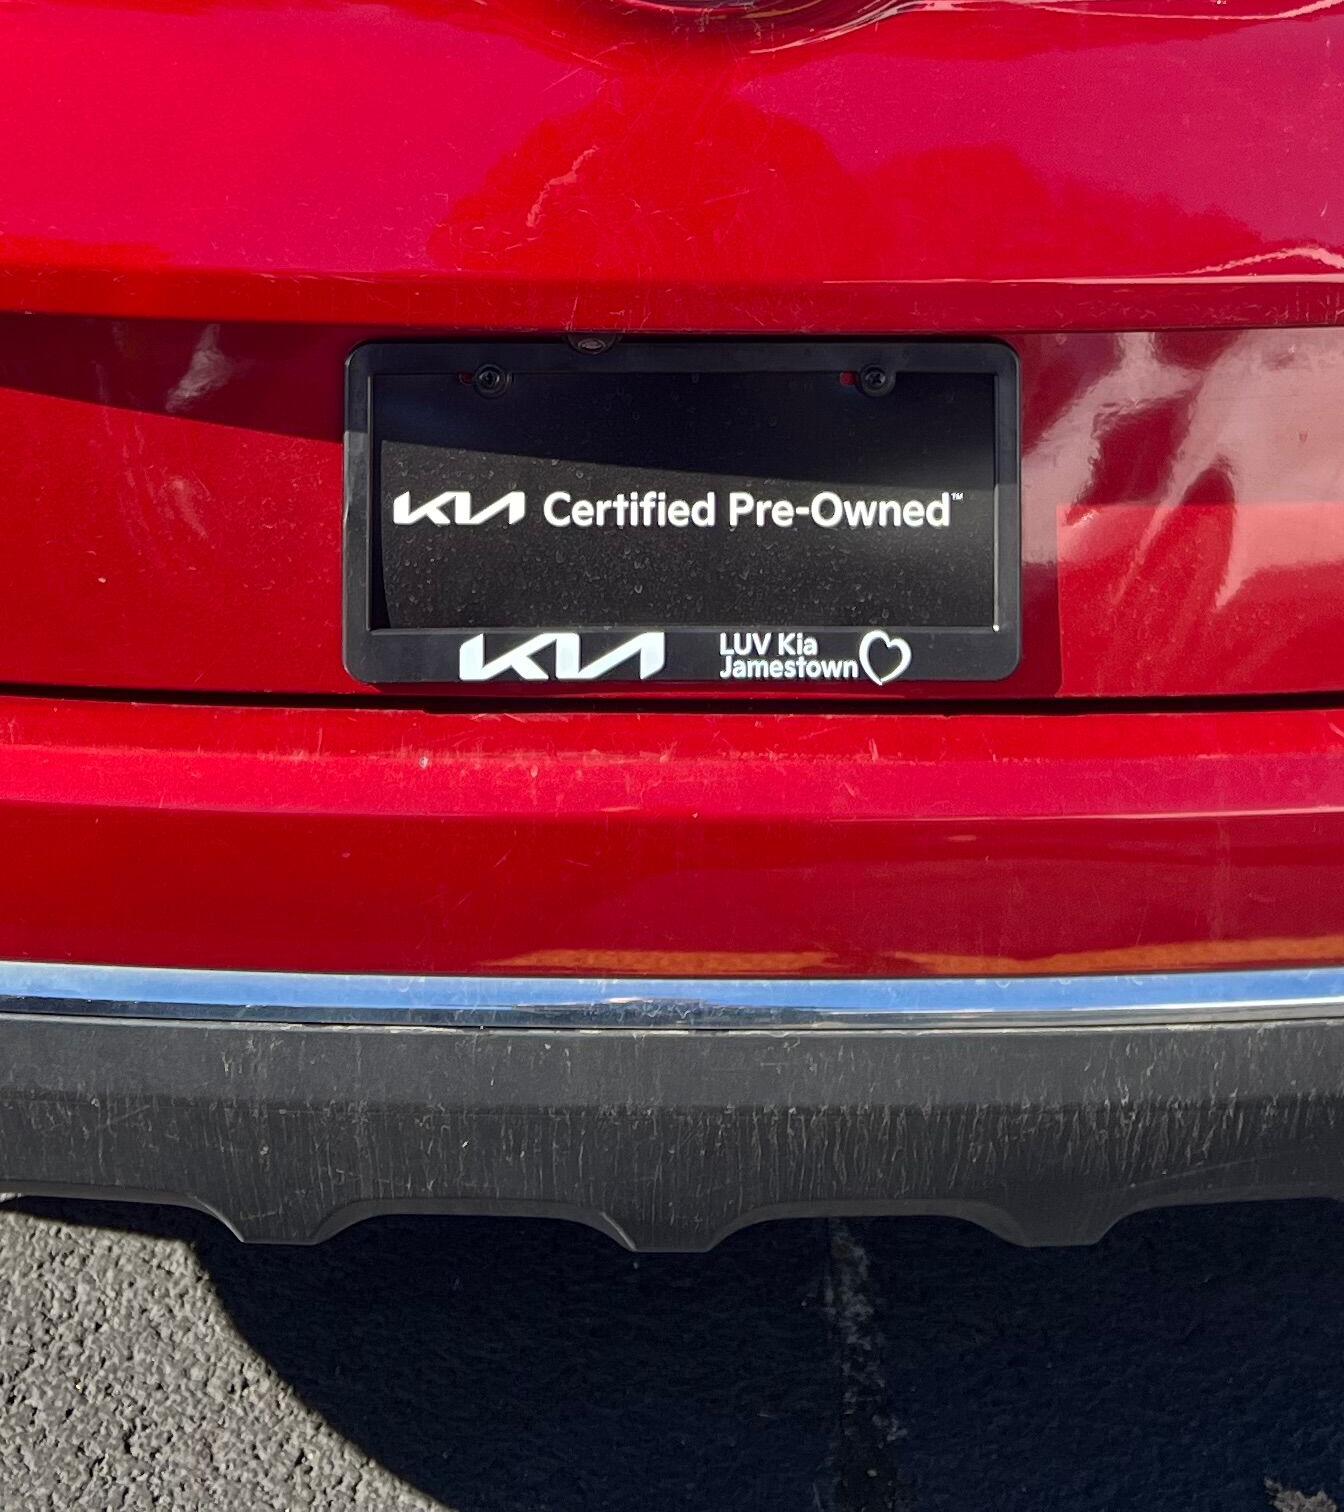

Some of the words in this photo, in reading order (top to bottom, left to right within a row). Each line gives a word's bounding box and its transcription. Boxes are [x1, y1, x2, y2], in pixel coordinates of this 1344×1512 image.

[393, 491, 526, 525] KIA
[543, 491, 716, 527] Certified
[459, 632, 665, 681] KIA
[719, 632, 772, 656] LUV
[778, 632, 818, 656] Kia
[719, 656, 859, 679] Jamestown
